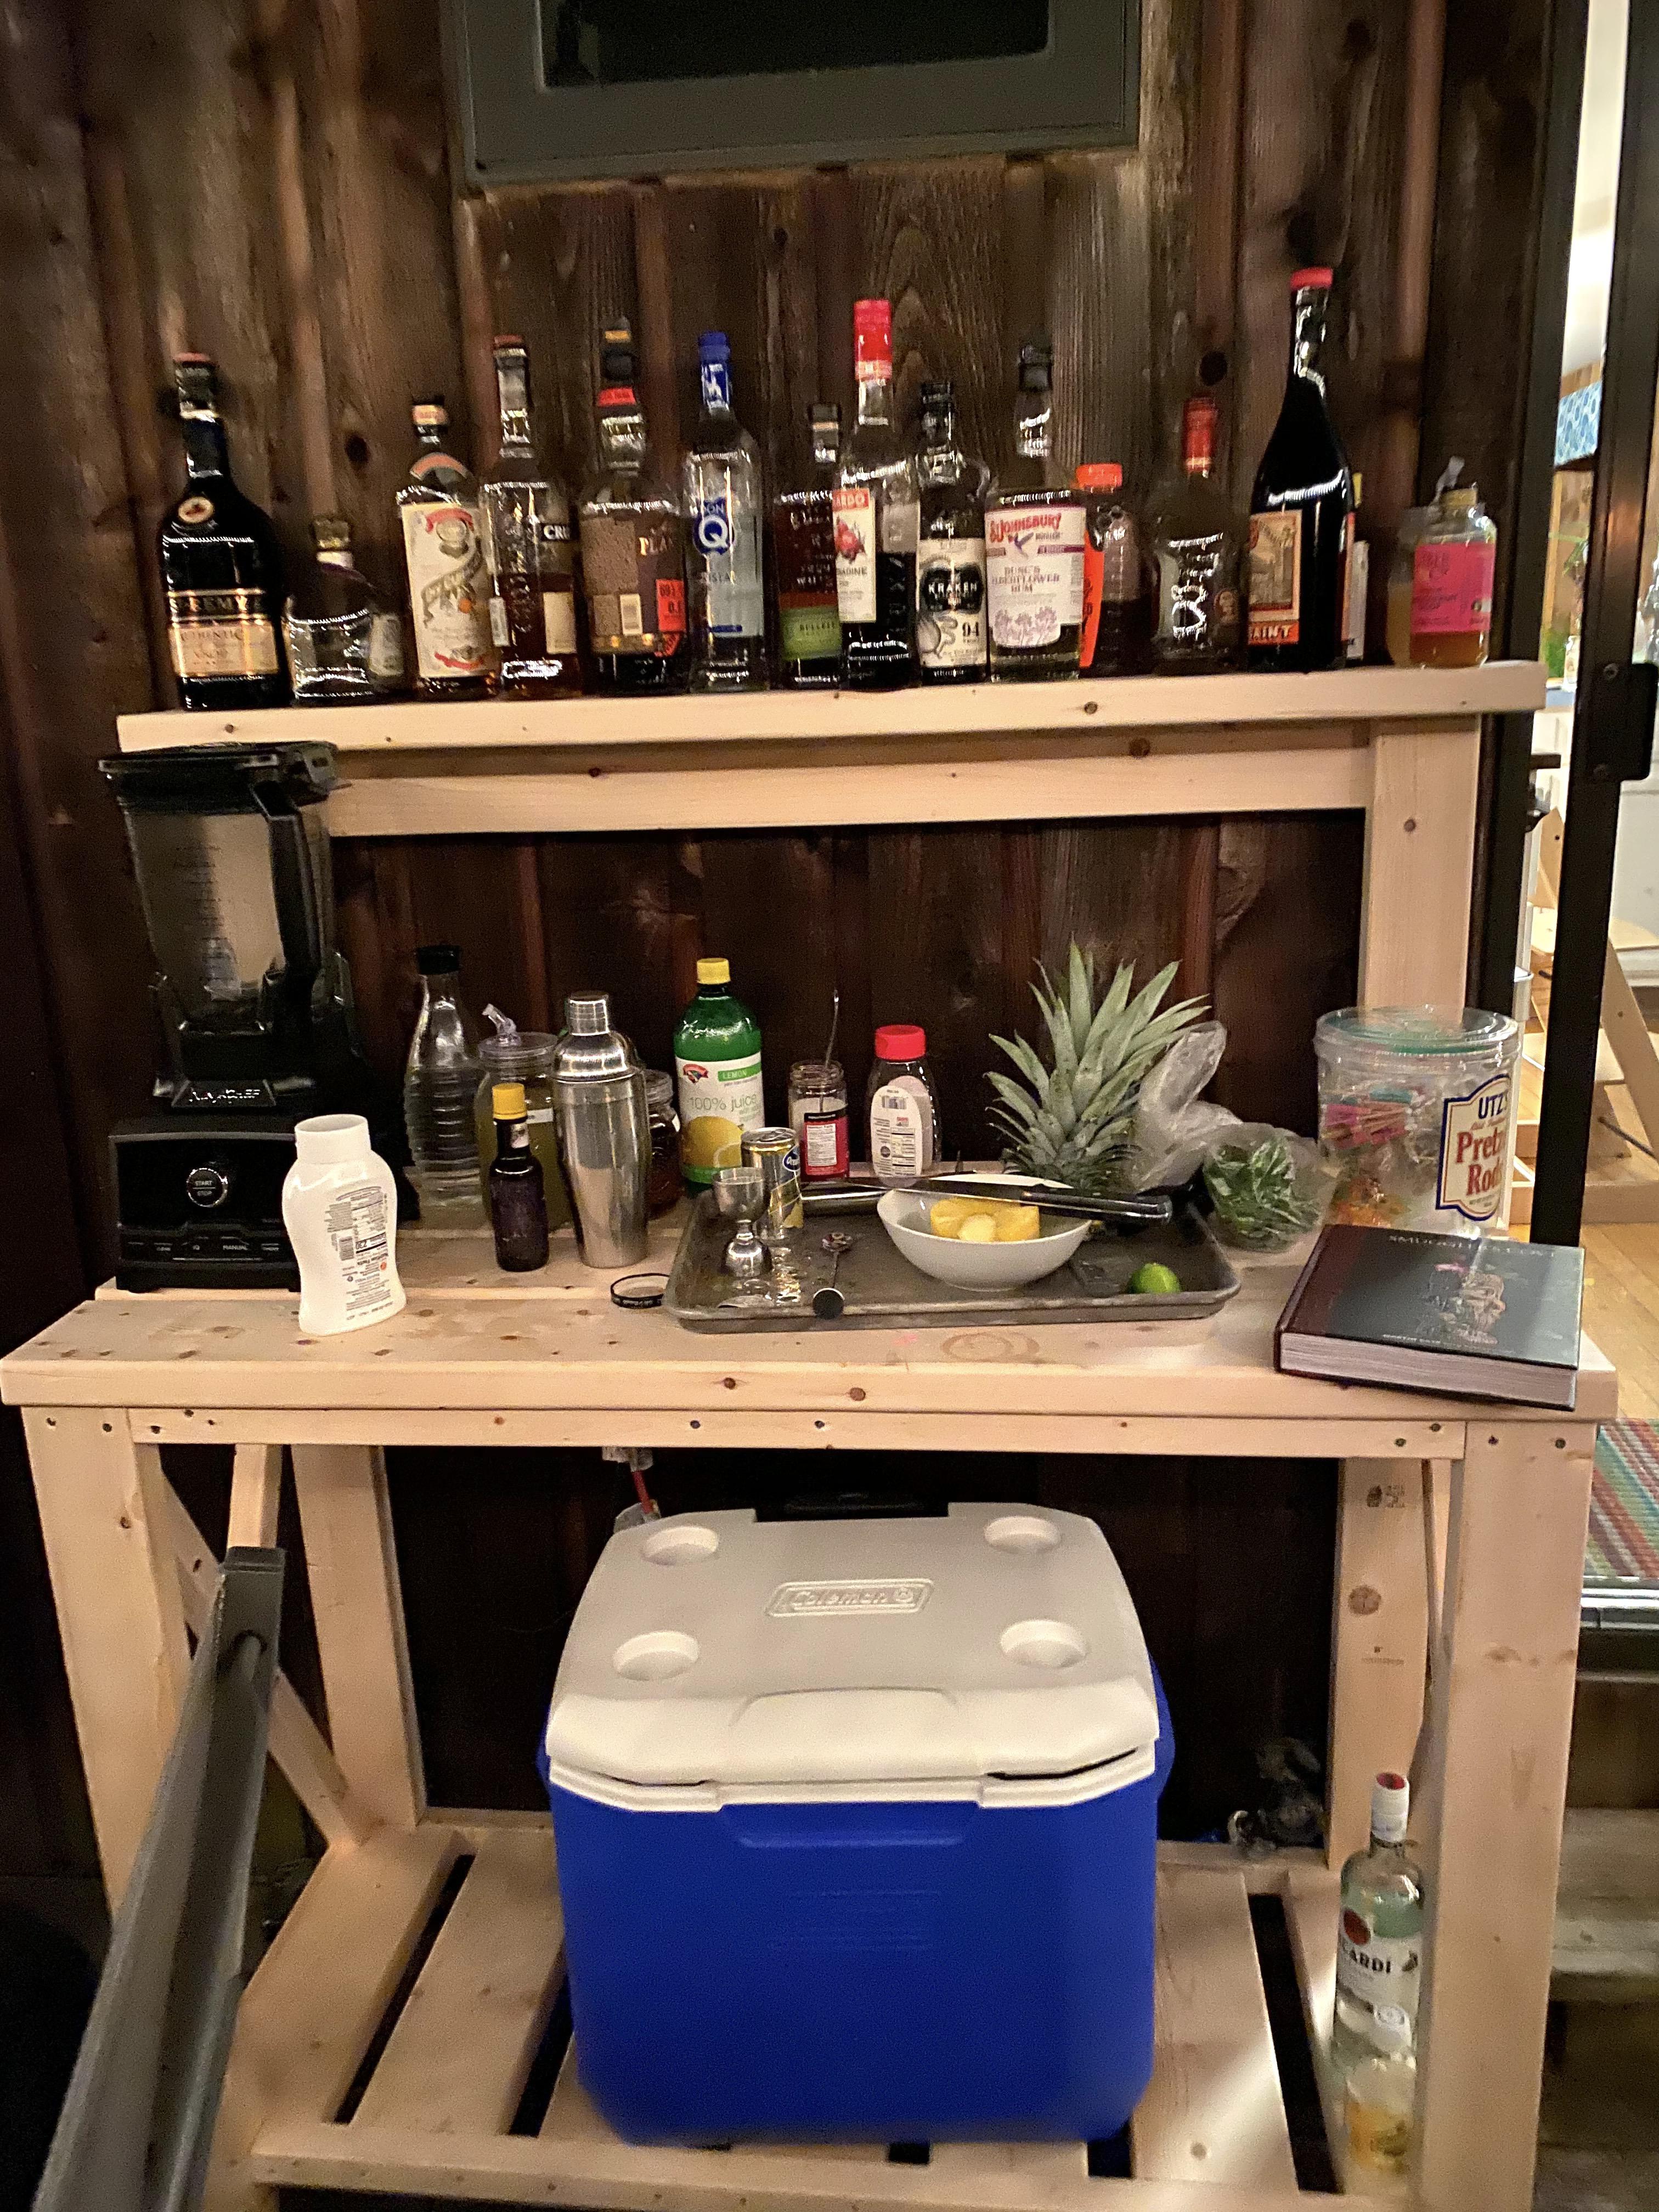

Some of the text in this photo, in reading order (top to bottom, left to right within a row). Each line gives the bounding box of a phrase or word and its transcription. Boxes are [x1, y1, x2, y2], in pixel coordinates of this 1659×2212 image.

[698, 515, 729, 548] Q
[928, 582, 978, 594] KRAKEN
[723, 1069, 748, 1080] LEMON
[688, 1094, 757, 1111] 100% juice
